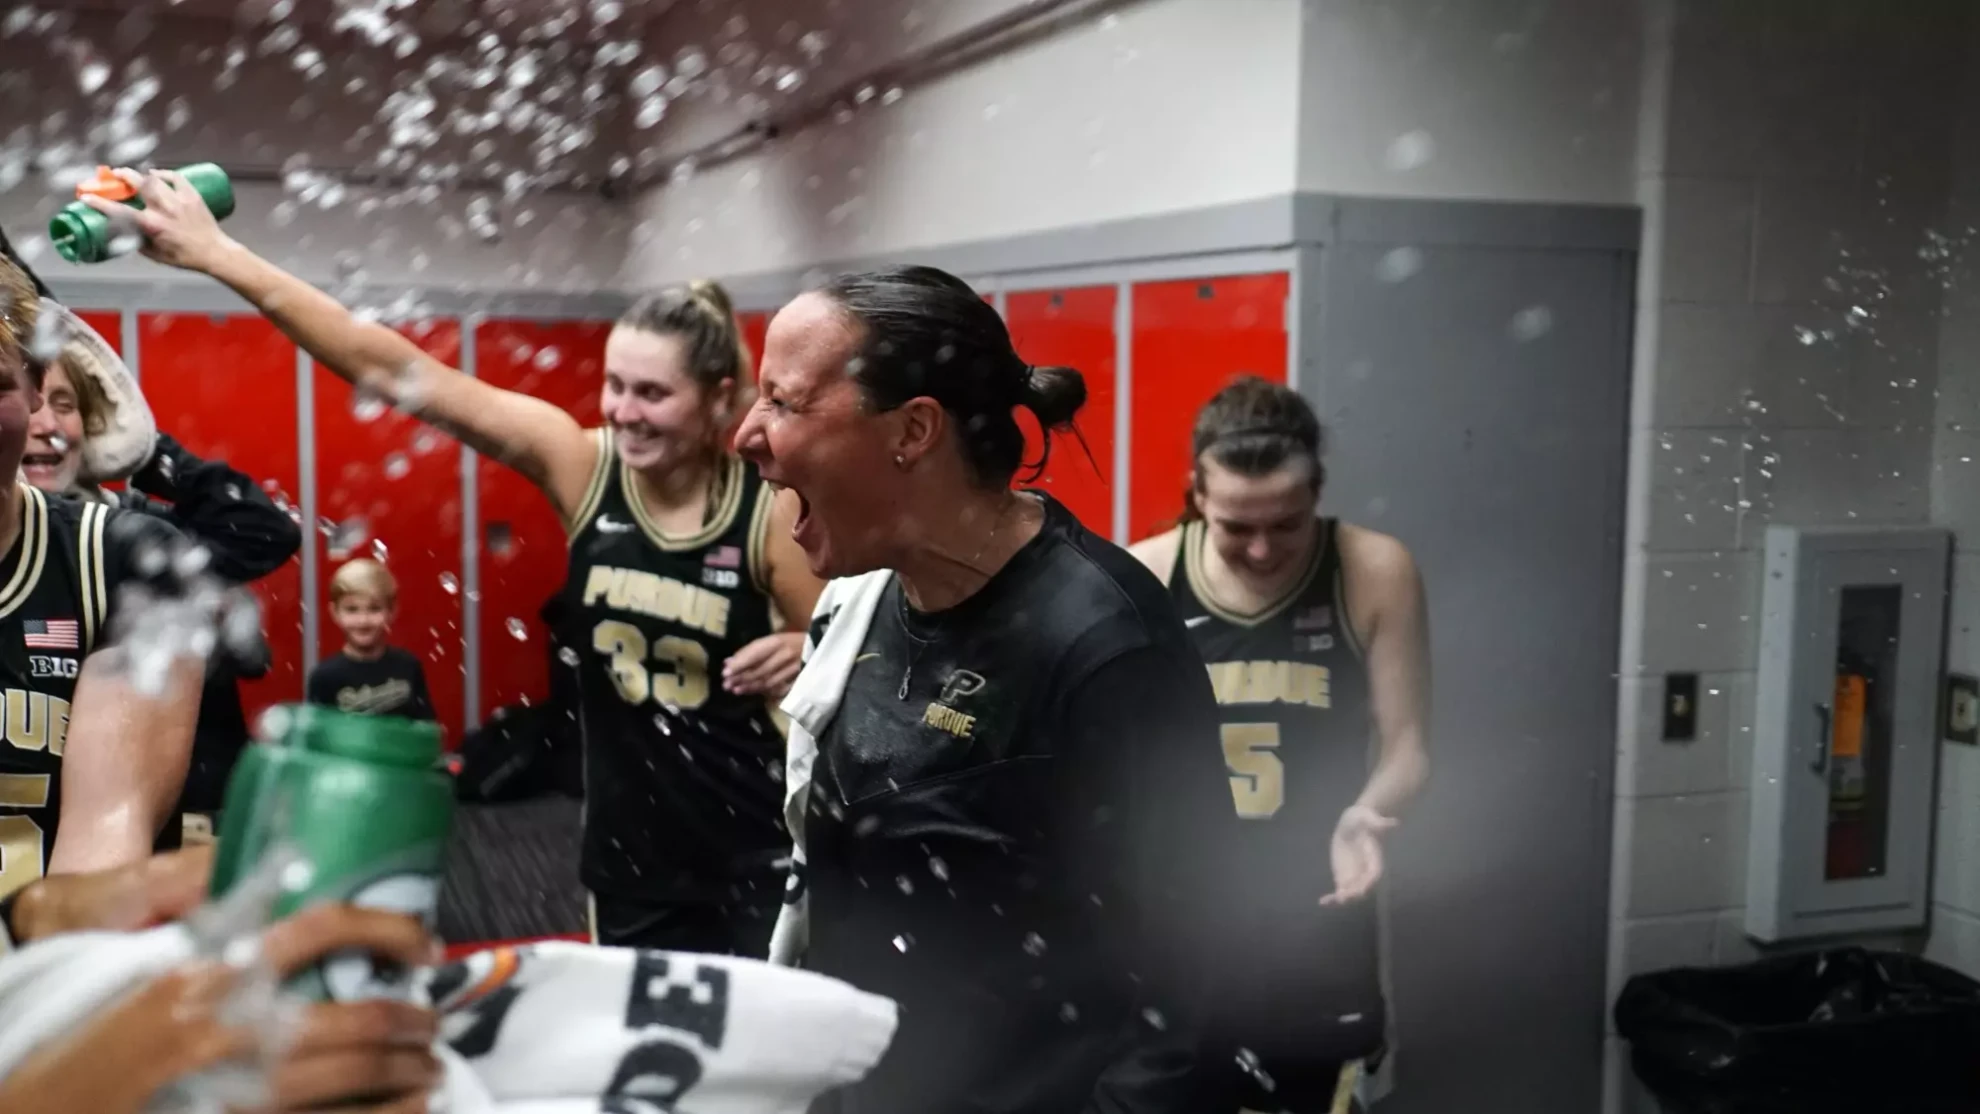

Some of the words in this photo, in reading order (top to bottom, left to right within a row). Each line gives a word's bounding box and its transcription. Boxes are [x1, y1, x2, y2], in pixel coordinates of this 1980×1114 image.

[583, 565, 731, 639] PURDUE
[593, 619, 709, 710] 33
[922, 702, 977, 738] PURDUE
[1220, 722, 1284, 820] 5
